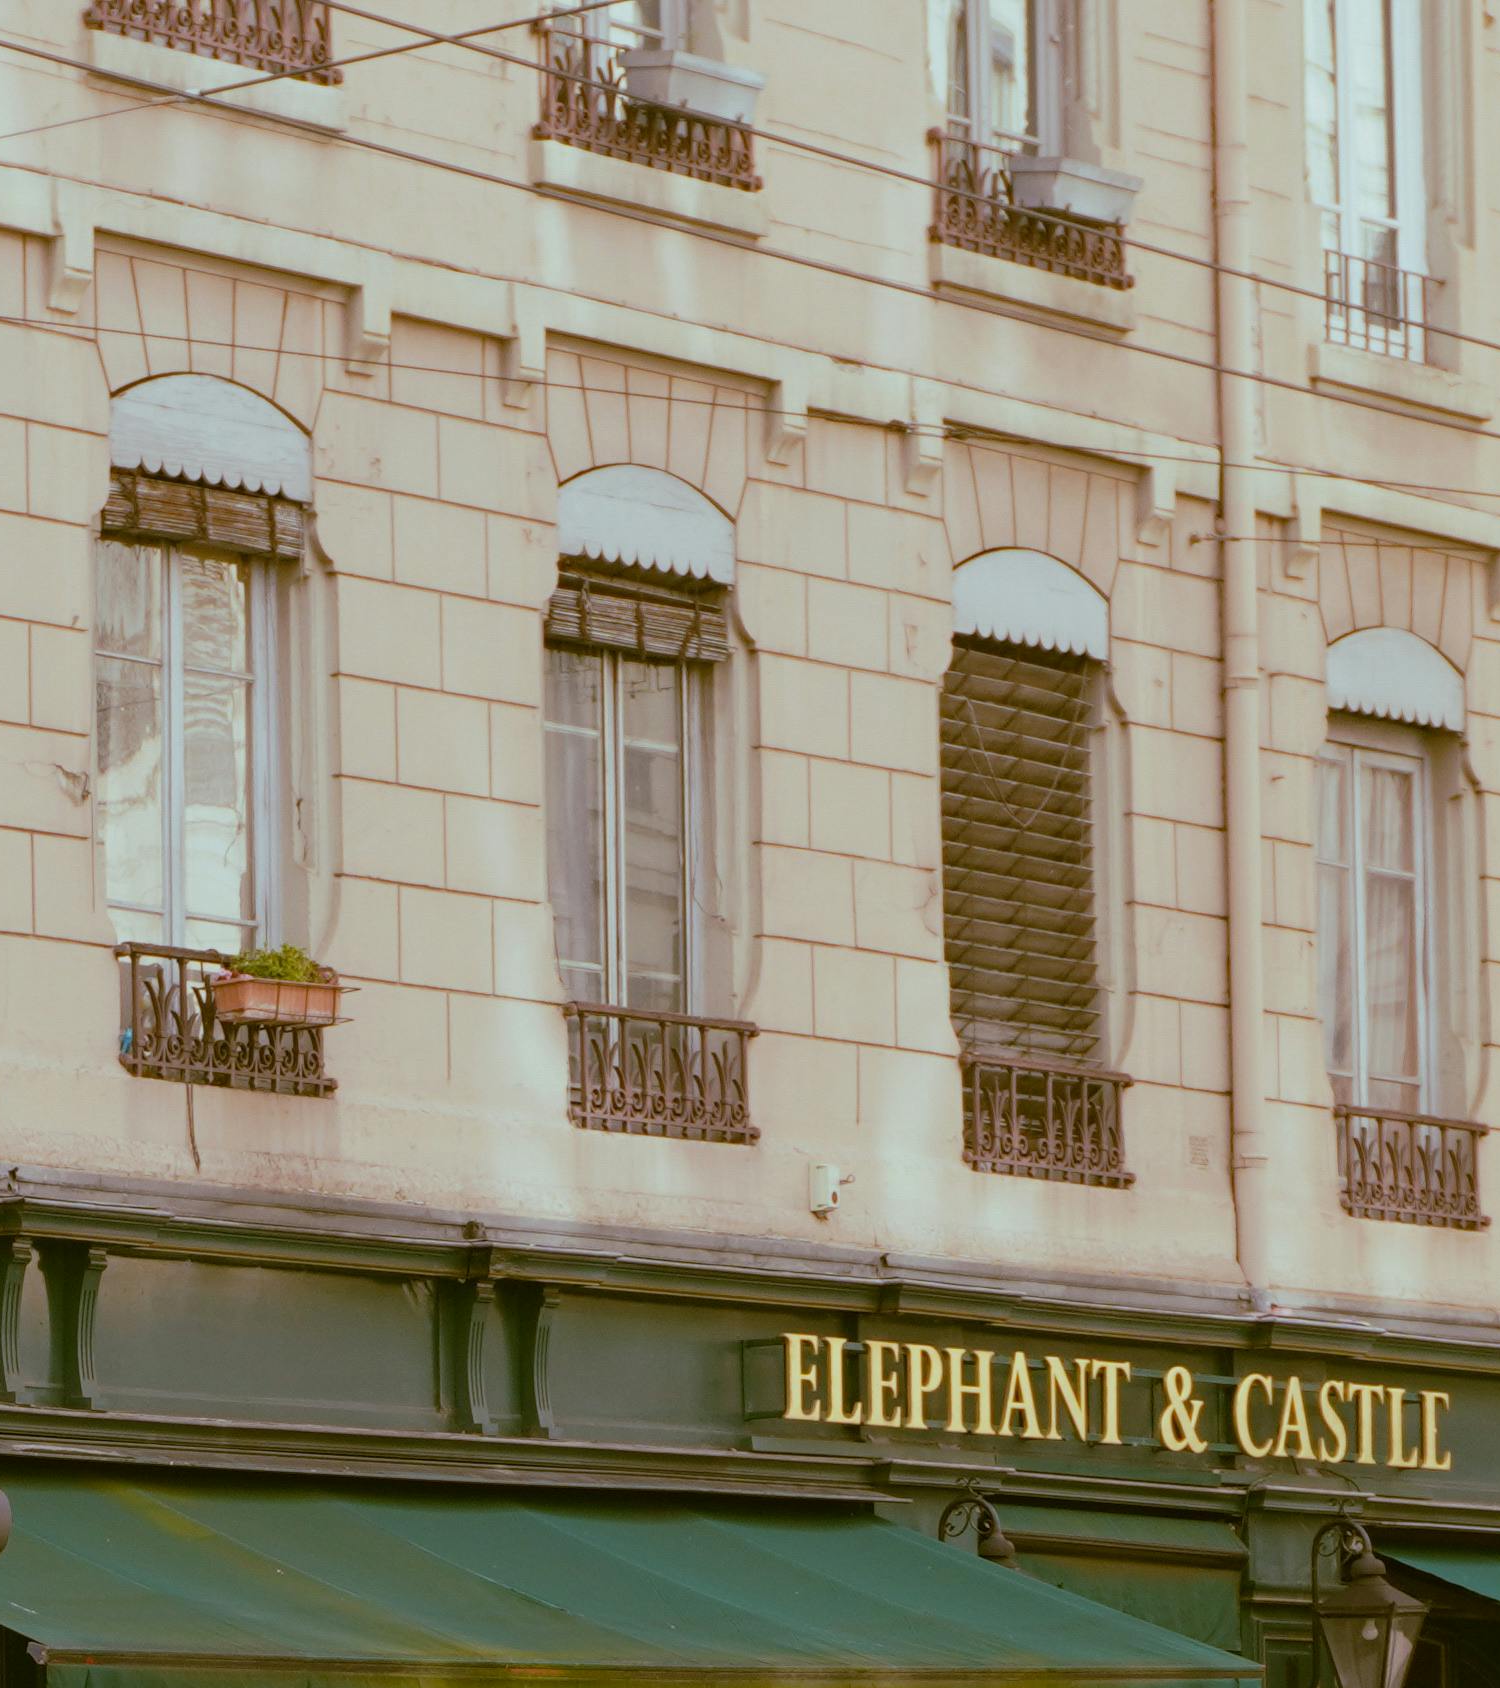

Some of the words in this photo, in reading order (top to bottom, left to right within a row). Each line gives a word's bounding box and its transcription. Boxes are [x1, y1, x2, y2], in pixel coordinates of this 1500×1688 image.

[782, 1331, 1131, 1446] ELEPHANT
[1159, 1365, 1208, 1454] &
[1233, 1371, 1453, 1472] CASTLE
